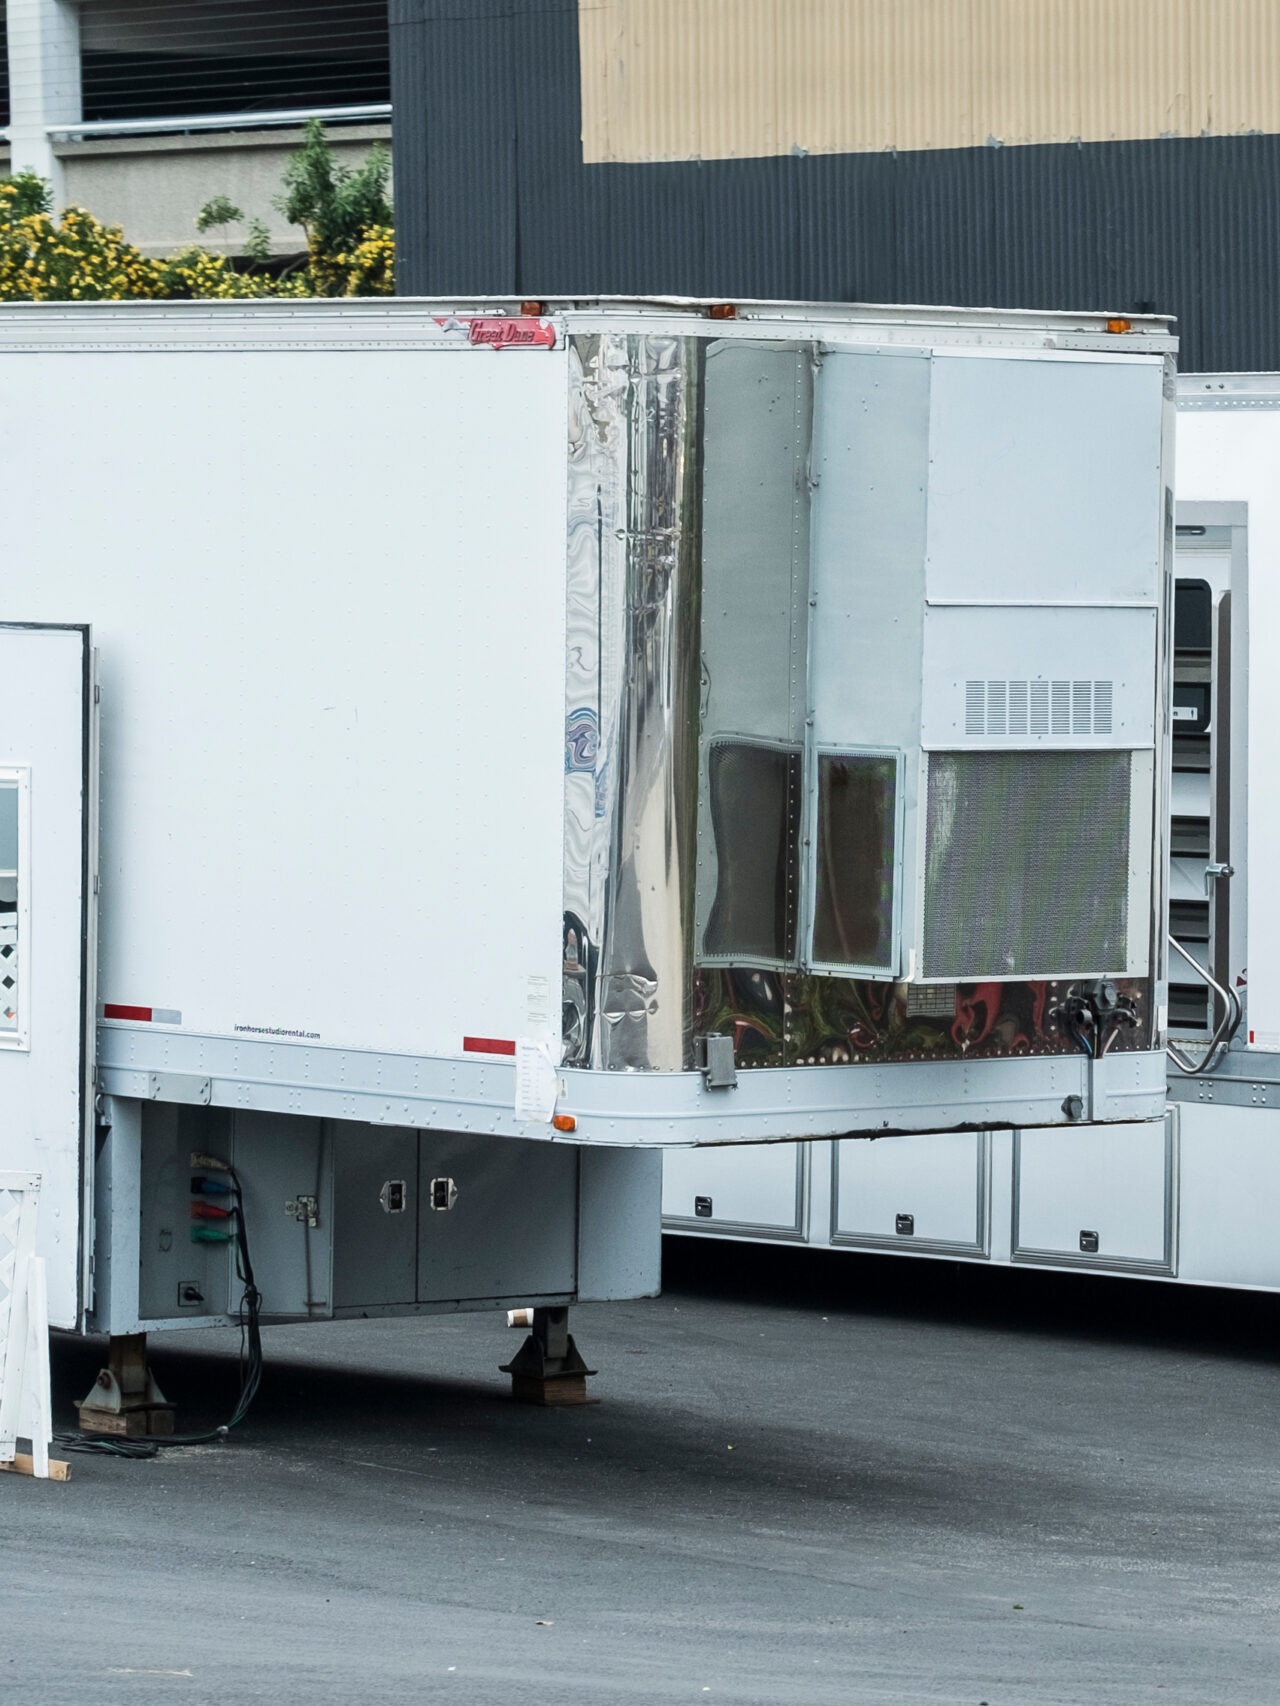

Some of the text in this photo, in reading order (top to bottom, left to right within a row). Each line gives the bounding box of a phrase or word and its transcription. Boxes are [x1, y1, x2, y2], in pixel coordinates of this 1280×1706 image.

[471, 322, 536, 343] Great Dane
[234, 1023, 321, 1040] ironhorsestudiorental.com
